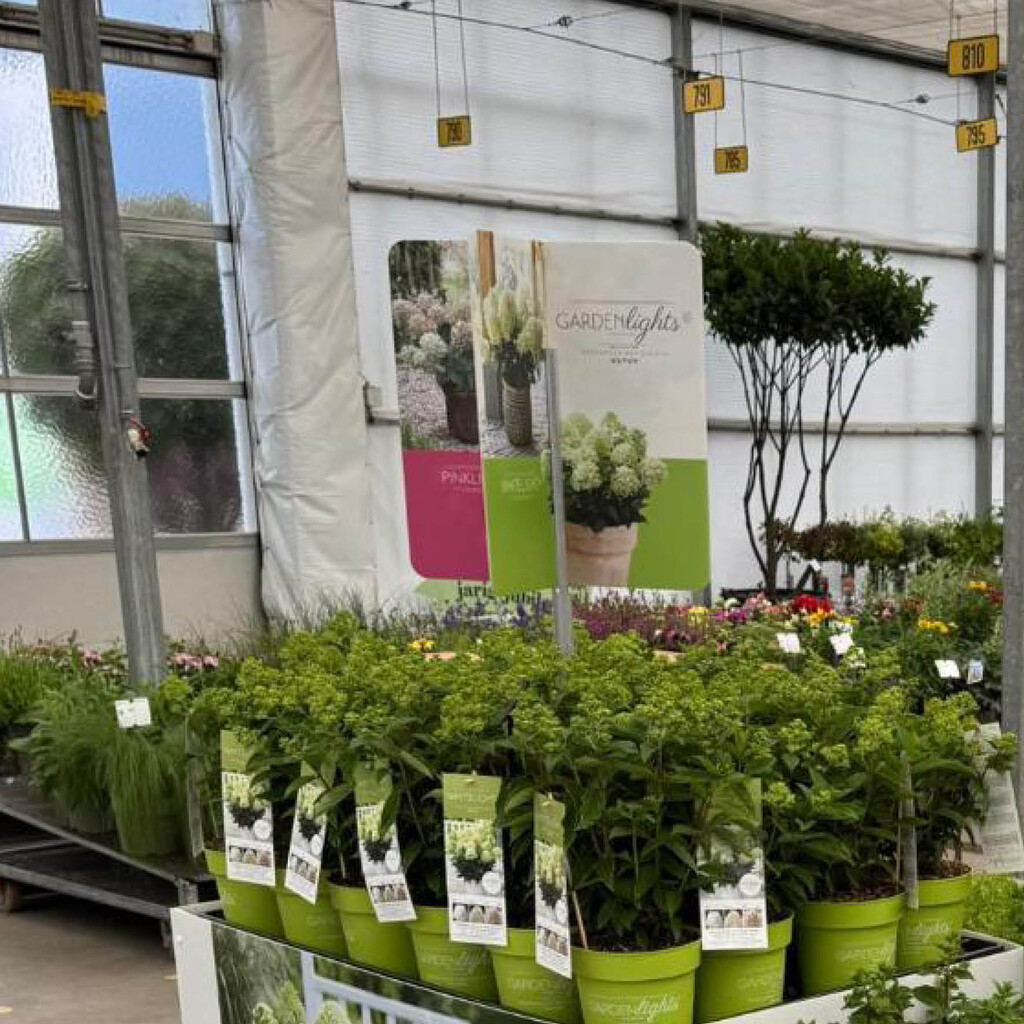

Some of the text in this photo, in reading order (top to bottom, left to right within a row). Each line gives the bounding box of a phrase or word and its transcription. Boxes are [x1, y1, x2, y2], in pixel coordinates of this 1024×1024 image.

[961, 42, 985, 71] 810
[691, 84, 711, 107] 791
[965, 124, 985, 146] 795
